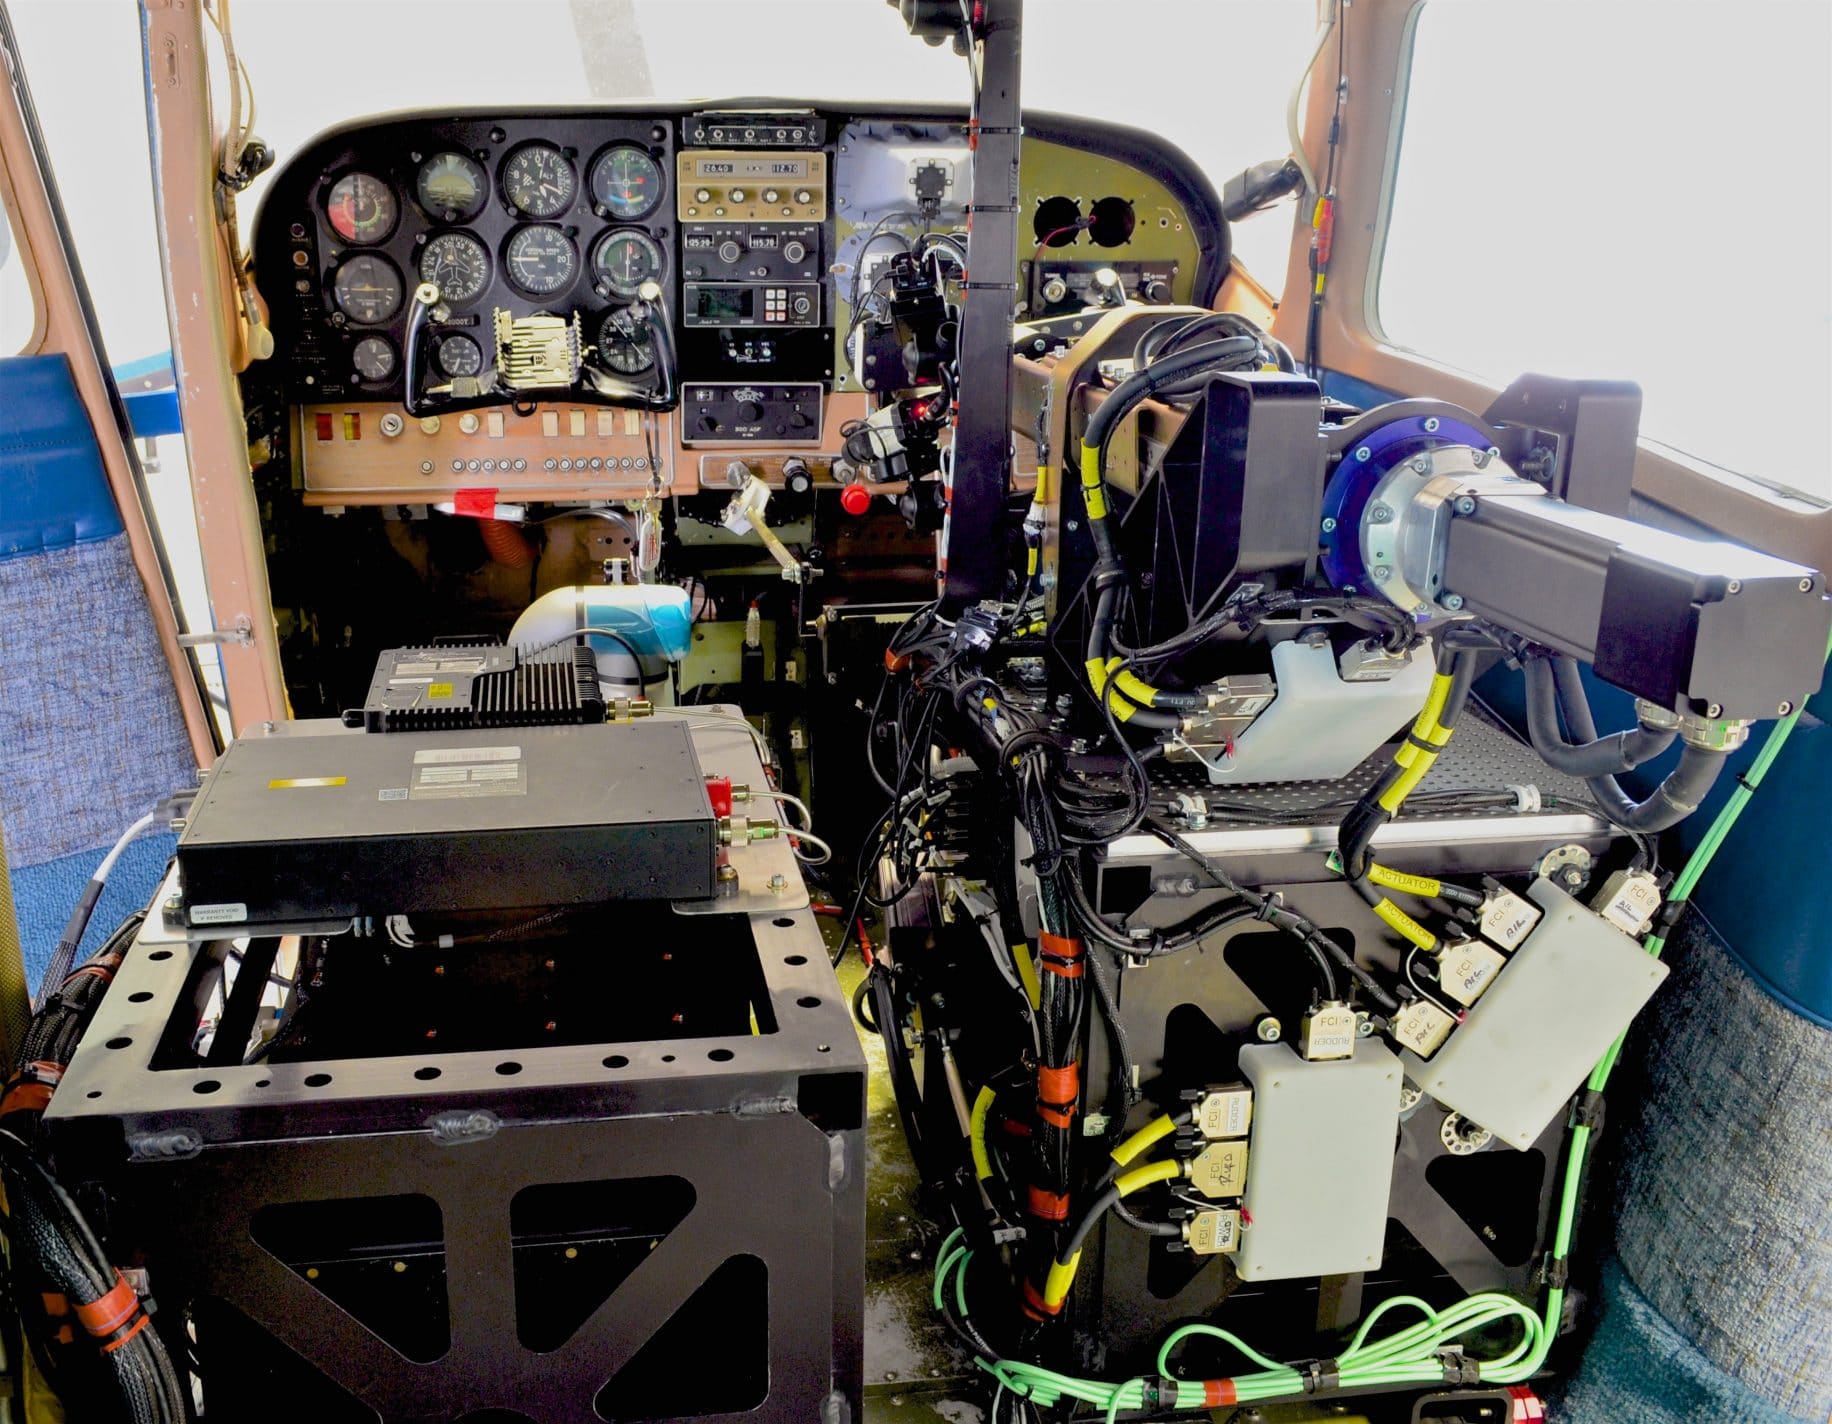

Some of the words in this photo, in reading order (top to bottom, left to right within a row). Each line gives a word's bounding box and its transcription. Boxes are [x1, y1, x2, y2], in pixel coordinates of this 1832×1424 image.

[1377, 868, 1436, 892] ACTUATOR
[1630, 884, 1647, 899] FCI
[1383, 901, 1433, 942] ACTUATOR
[1488, 908, 1505, 928] FCI
[1456, 957, 1473, 977] FCI
[1320, 1017, 1338, 1027] FCI
[1403, 1017, 1420, 1036] FCI
[1313, 1036, 1350, 1047] RUDDER
[1208, 1111, 1218, 1129] FCI
[1229, 1097, 1241, 1133] RUDDER
[1210, 1161, 1220, 1180] FCI
[1198, 1227, 1209, 1247] FCI
